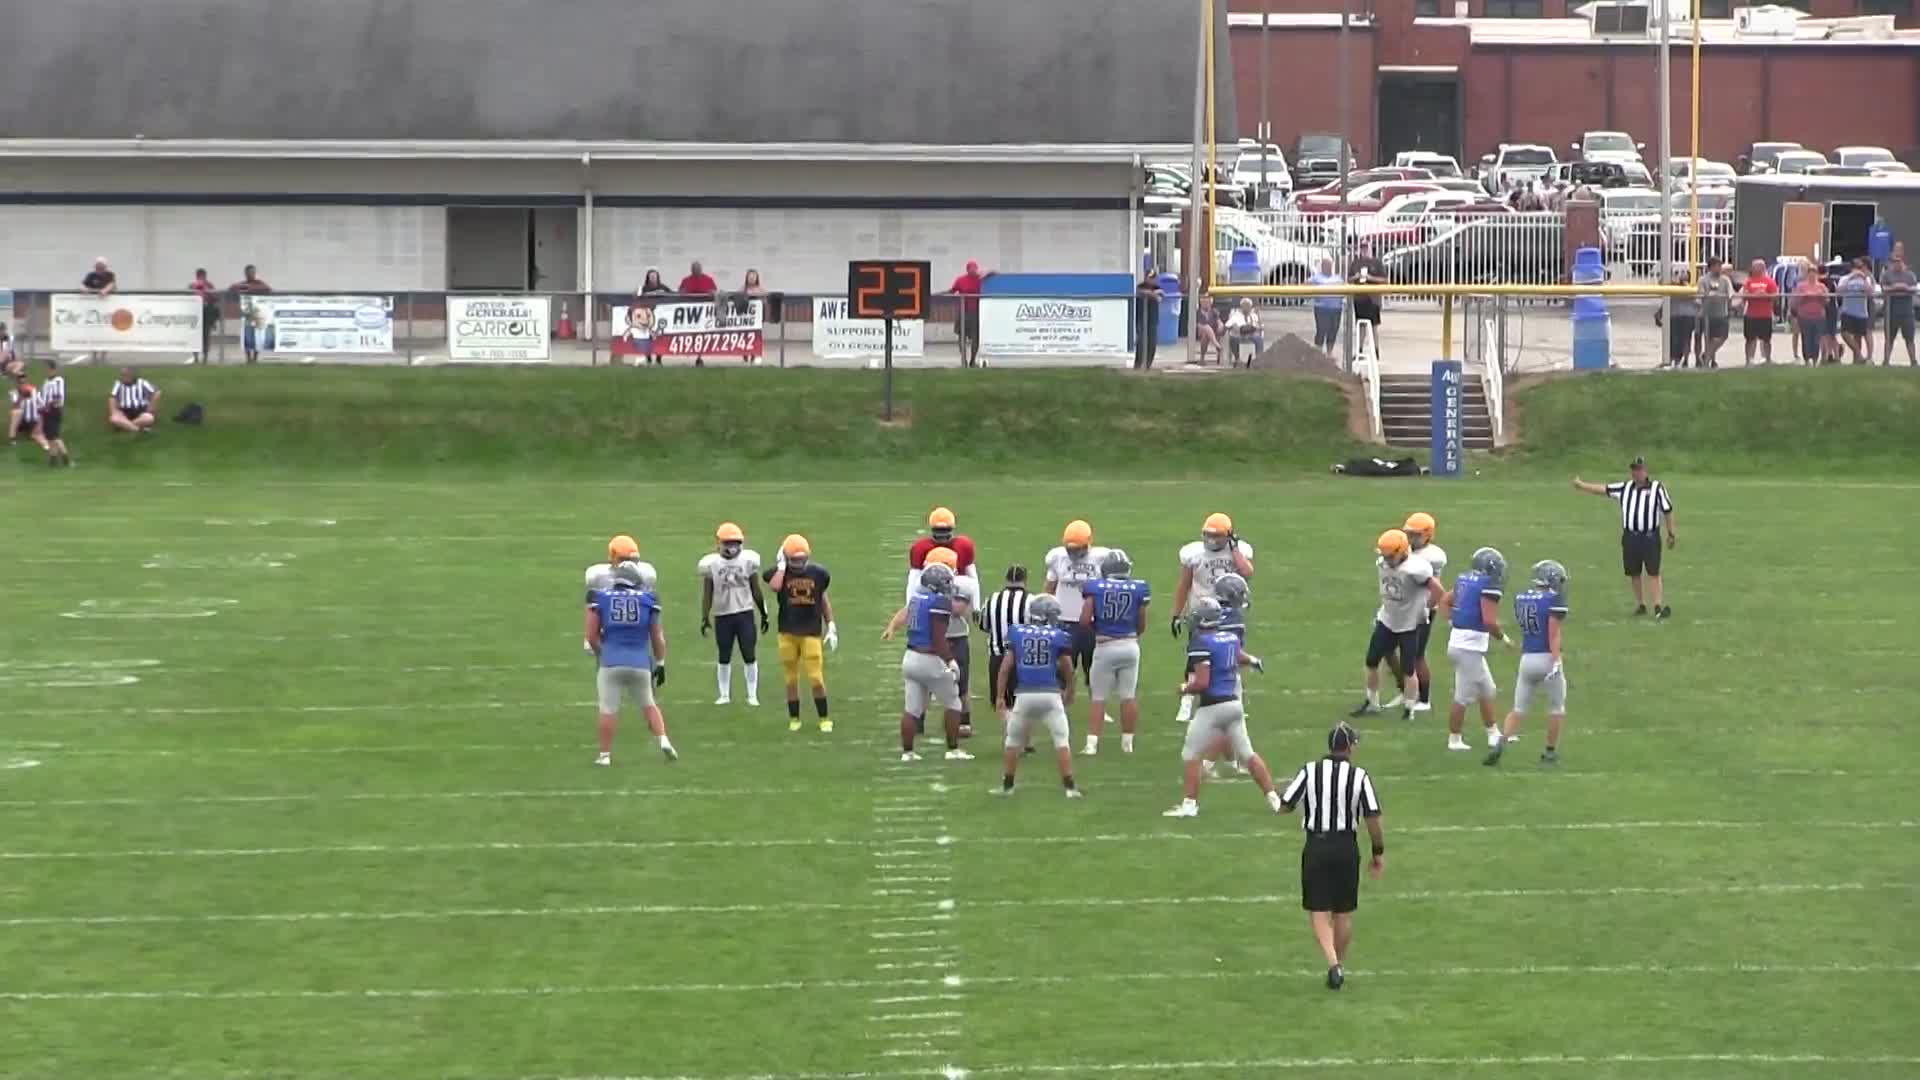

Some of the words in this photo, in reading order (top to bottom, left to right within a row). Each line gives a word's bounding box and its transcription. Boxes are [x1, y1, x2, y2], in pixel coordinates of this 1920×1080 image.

[858, 266, 922, 316] 23
[673, 305, 703, 325] AW
[820, 301, 838, 320] AW
[456, 320, 542, 337] CARROLL
[826, 327, 884, 337] SUPPORTS
[669, 332, 756, 353] 419.877.2942
[1445, 387, 1457, 472] GENERALS
[610, 597, 641, 624] 59
[1103, 591, 1134, 618] 52
[1022, 637, 1049, 666] 36
